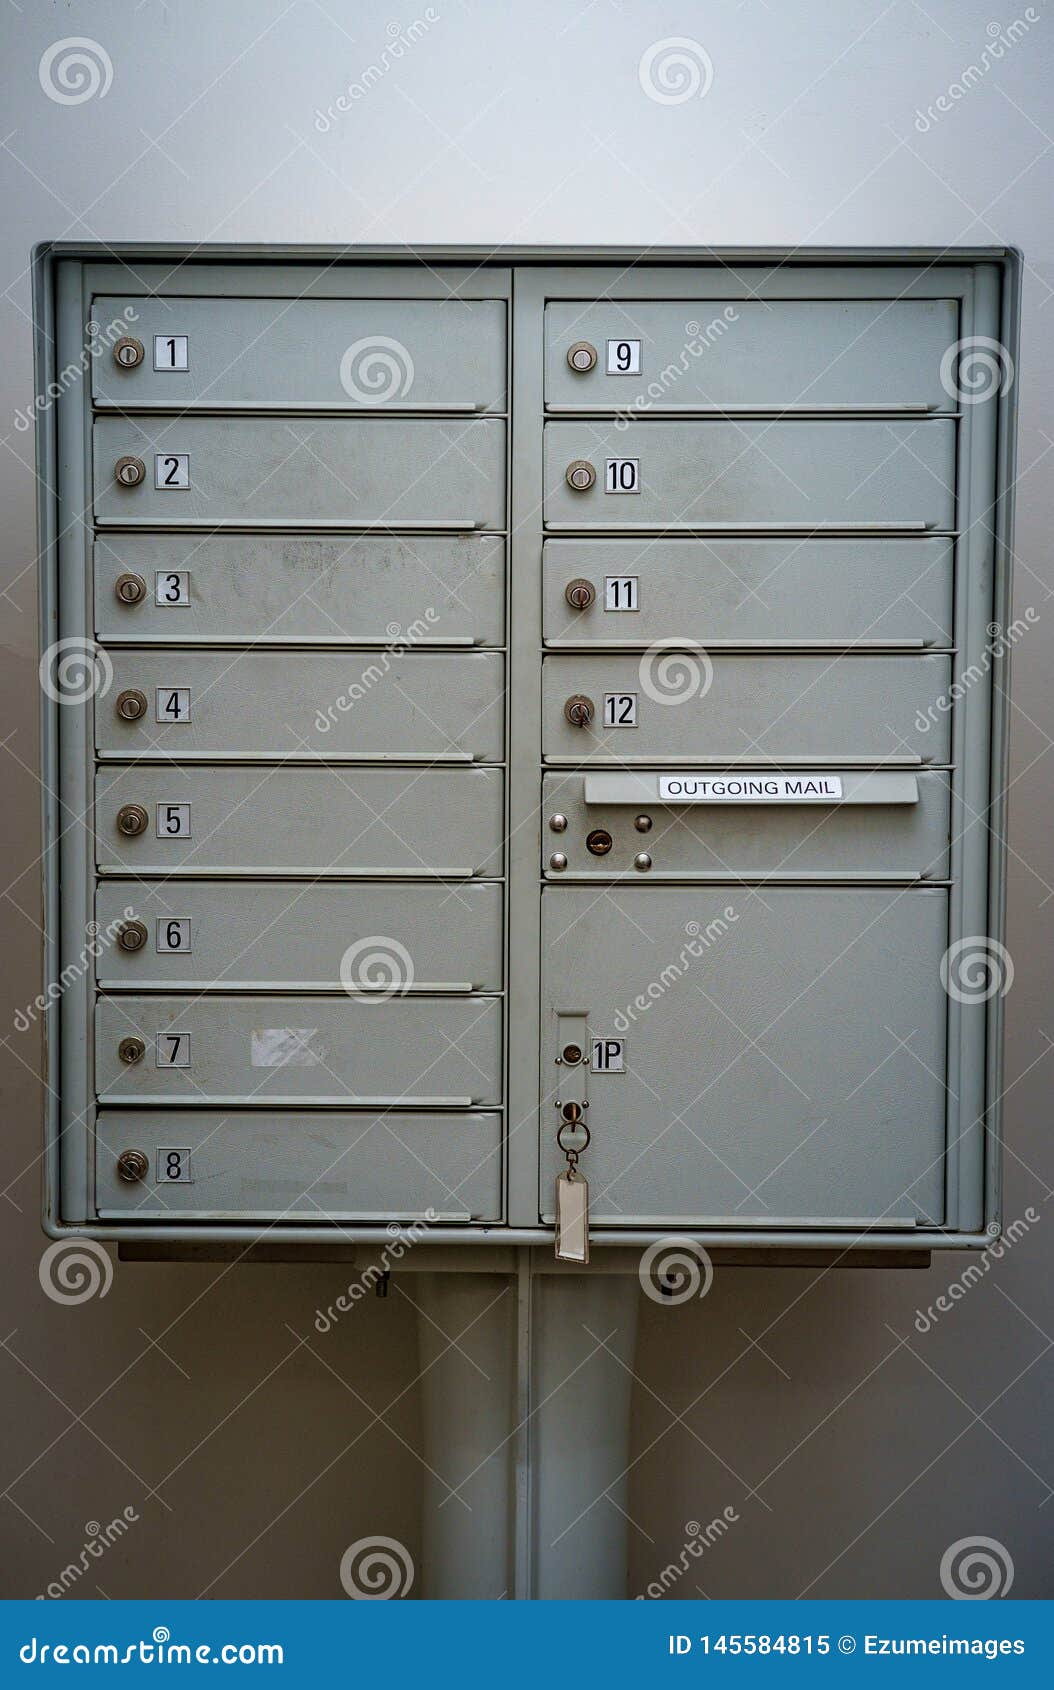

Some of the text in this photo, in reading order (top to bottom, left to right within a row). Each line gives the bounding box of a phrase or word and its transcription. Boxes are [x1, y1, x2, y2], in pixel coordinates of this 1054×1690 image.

[166, 338, 176, 367] 1
[616, 342, 632, 371] 9
[164, 457, 180, 485] 2
[608, 461, 636, 490] 10
[165, 573, 181, 602] 3
[610, 580, 632, 608] 11
[165, 691, 182, 719] 4
[607, 696, 633, 724] 12
[667, 781, 836, 795] OUTGOING MAIL
[166, 806, 181, 834] 5
[166, 920, 182, 949] 6
[166, 1036, 181, 1064] 7
[594, 1041, 621, 1069] 1P
[166, 1151, 182, 1180] 8
